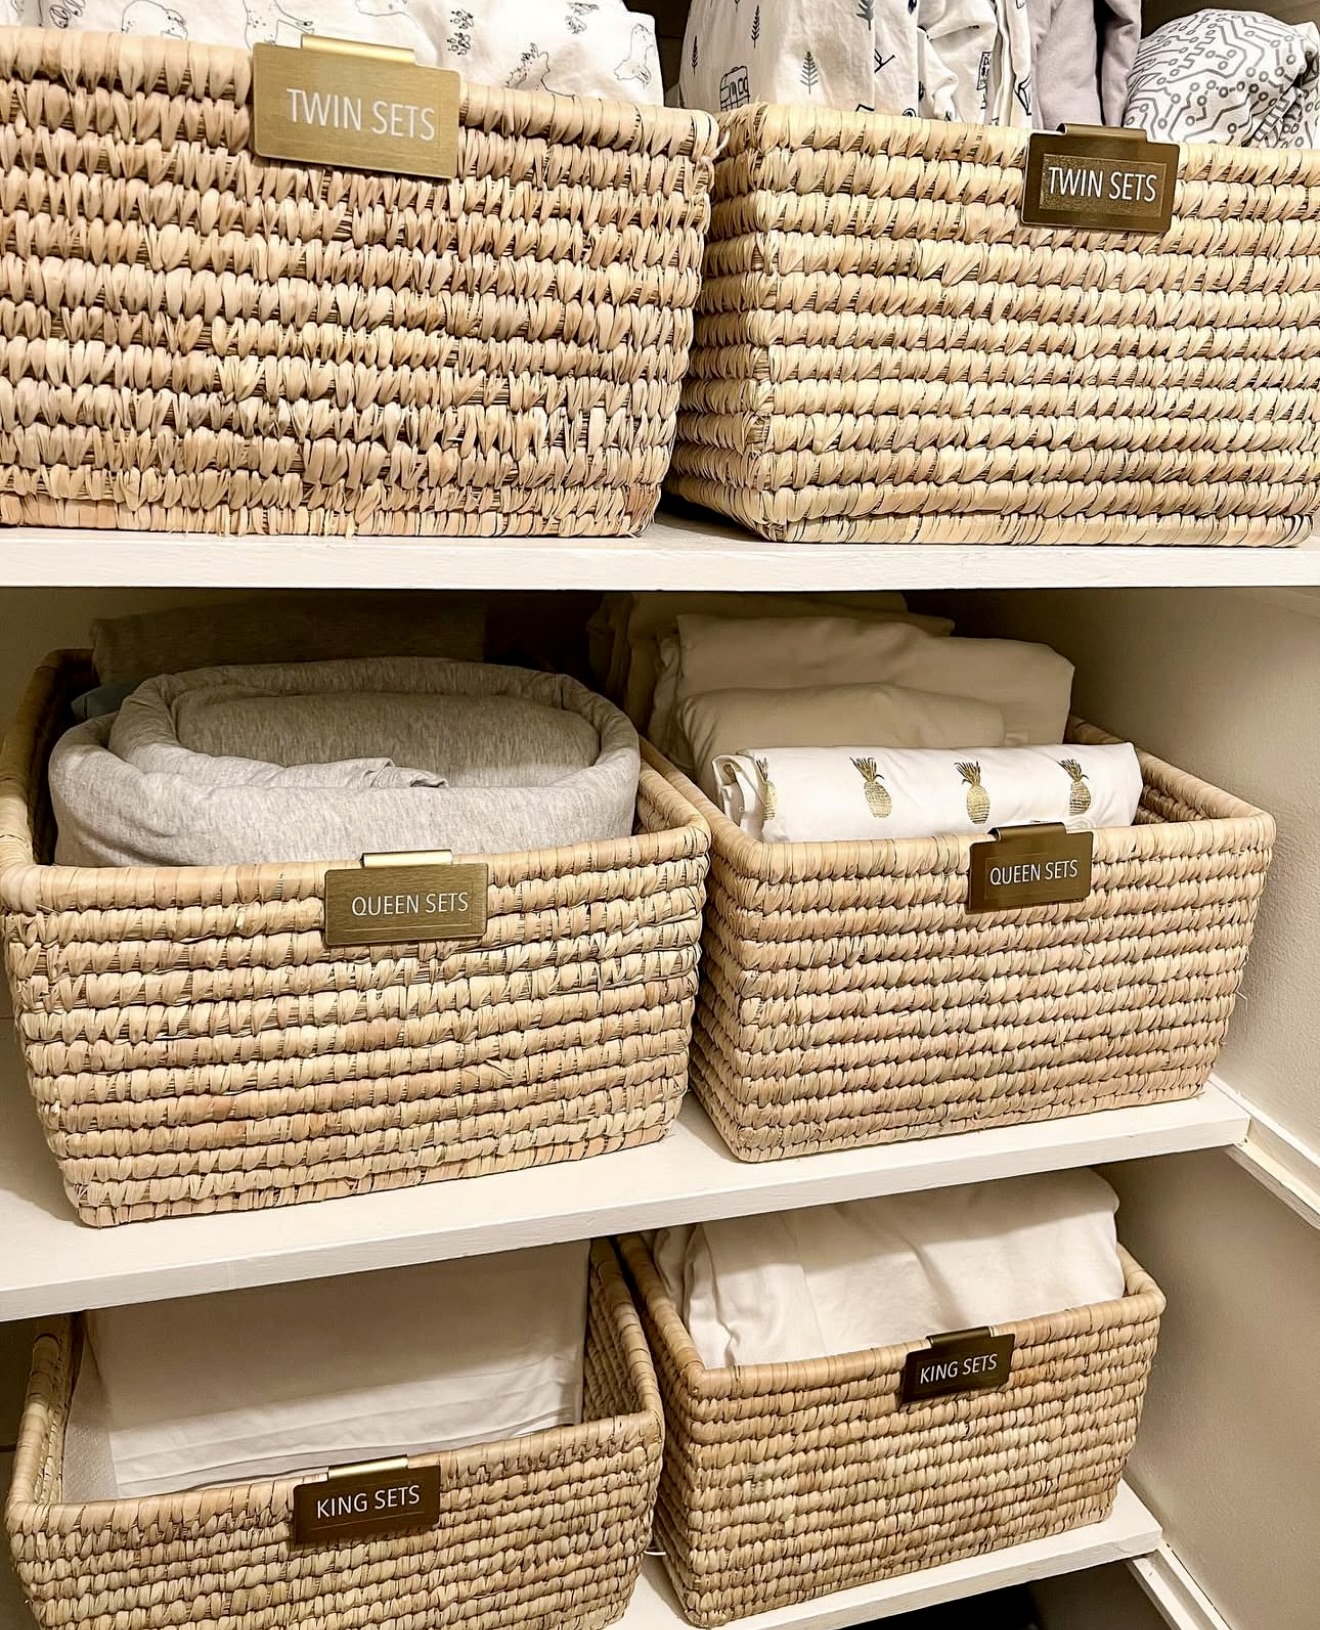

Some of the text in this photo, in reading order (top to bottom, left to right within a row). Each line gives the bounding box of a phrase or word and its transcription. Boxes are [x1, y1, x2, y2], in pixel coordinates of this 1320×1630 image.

[286, 87, 436, 142] TWIN SETS
[1048, 166, 1158, 203] TWIN SETS
[989, 859, 1078, 886] QUEEN SETS
[351, 891, 469, 917] QUEEN SETS
[919, 1352, 999, 1385] KING SETS
[316, 1484, 420, 1520] KING SETS
